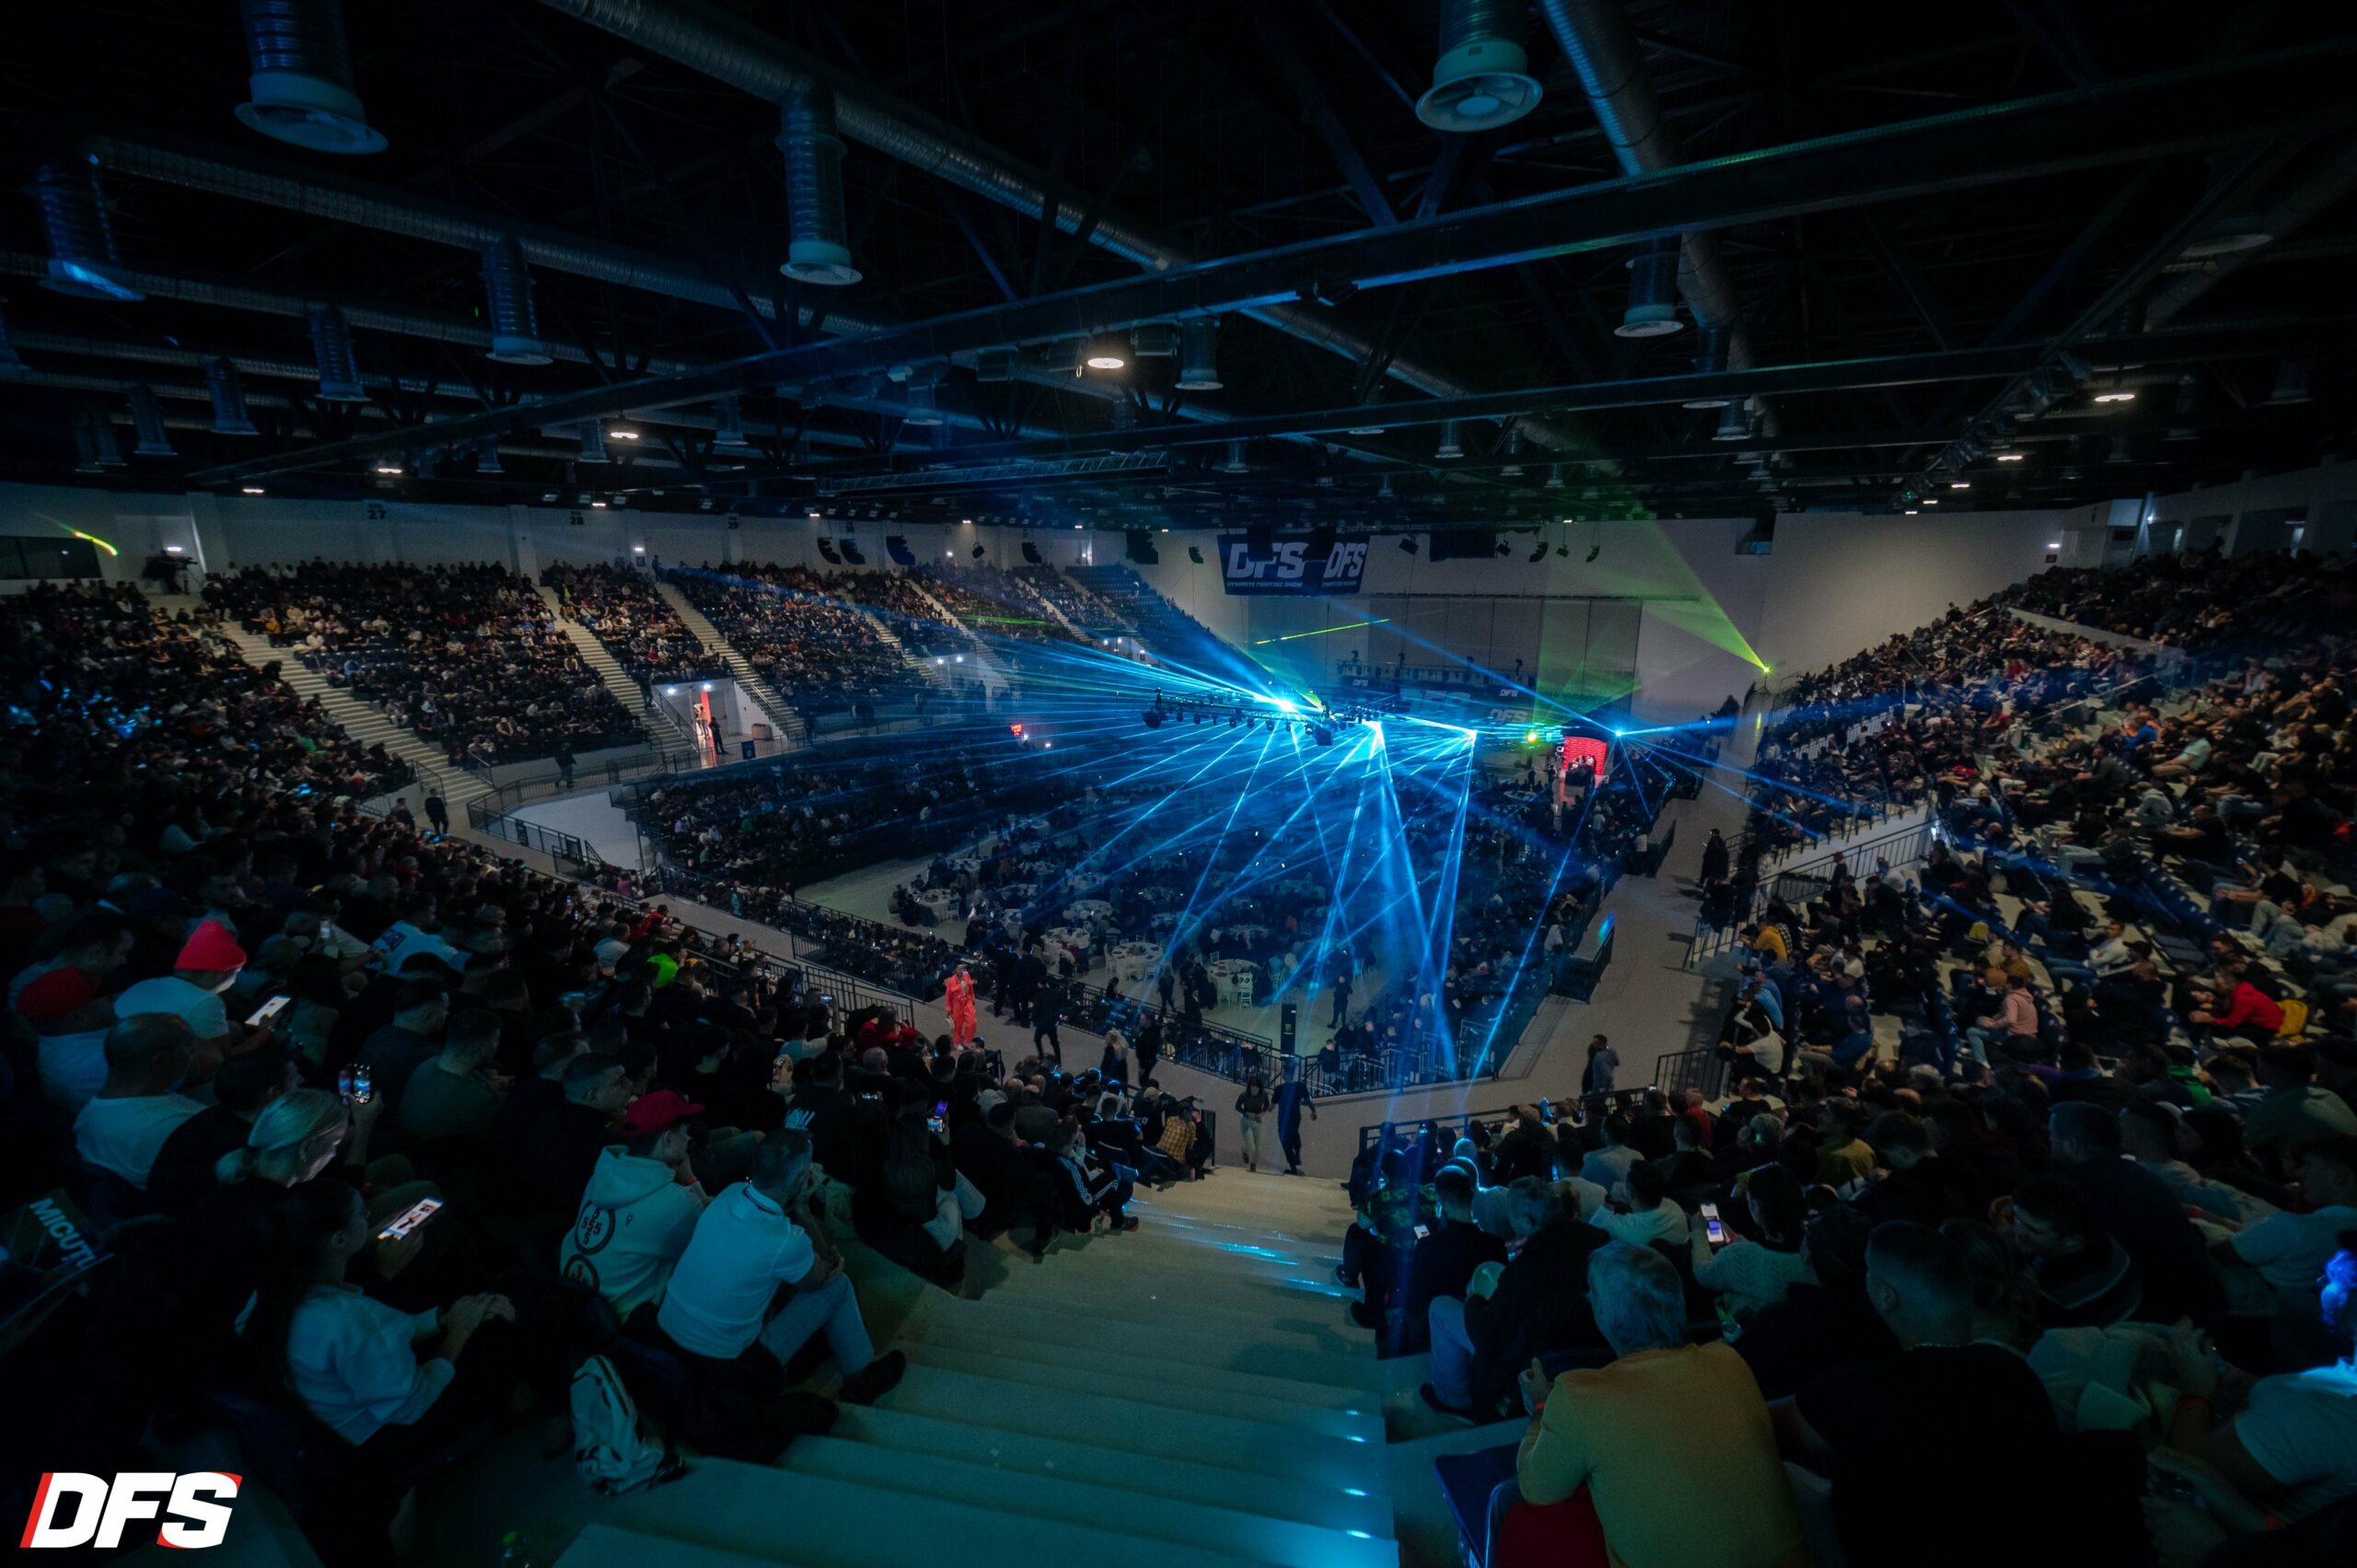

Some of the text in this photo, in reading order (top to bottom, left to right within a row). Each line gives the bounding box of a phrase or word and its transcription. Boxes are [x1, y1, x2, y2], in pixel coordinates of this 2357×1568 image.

[367, 509, 386, 519] 27
[1323, 541, 1368, 578] DFS
[1500, 689, 1519, 697] DFS
